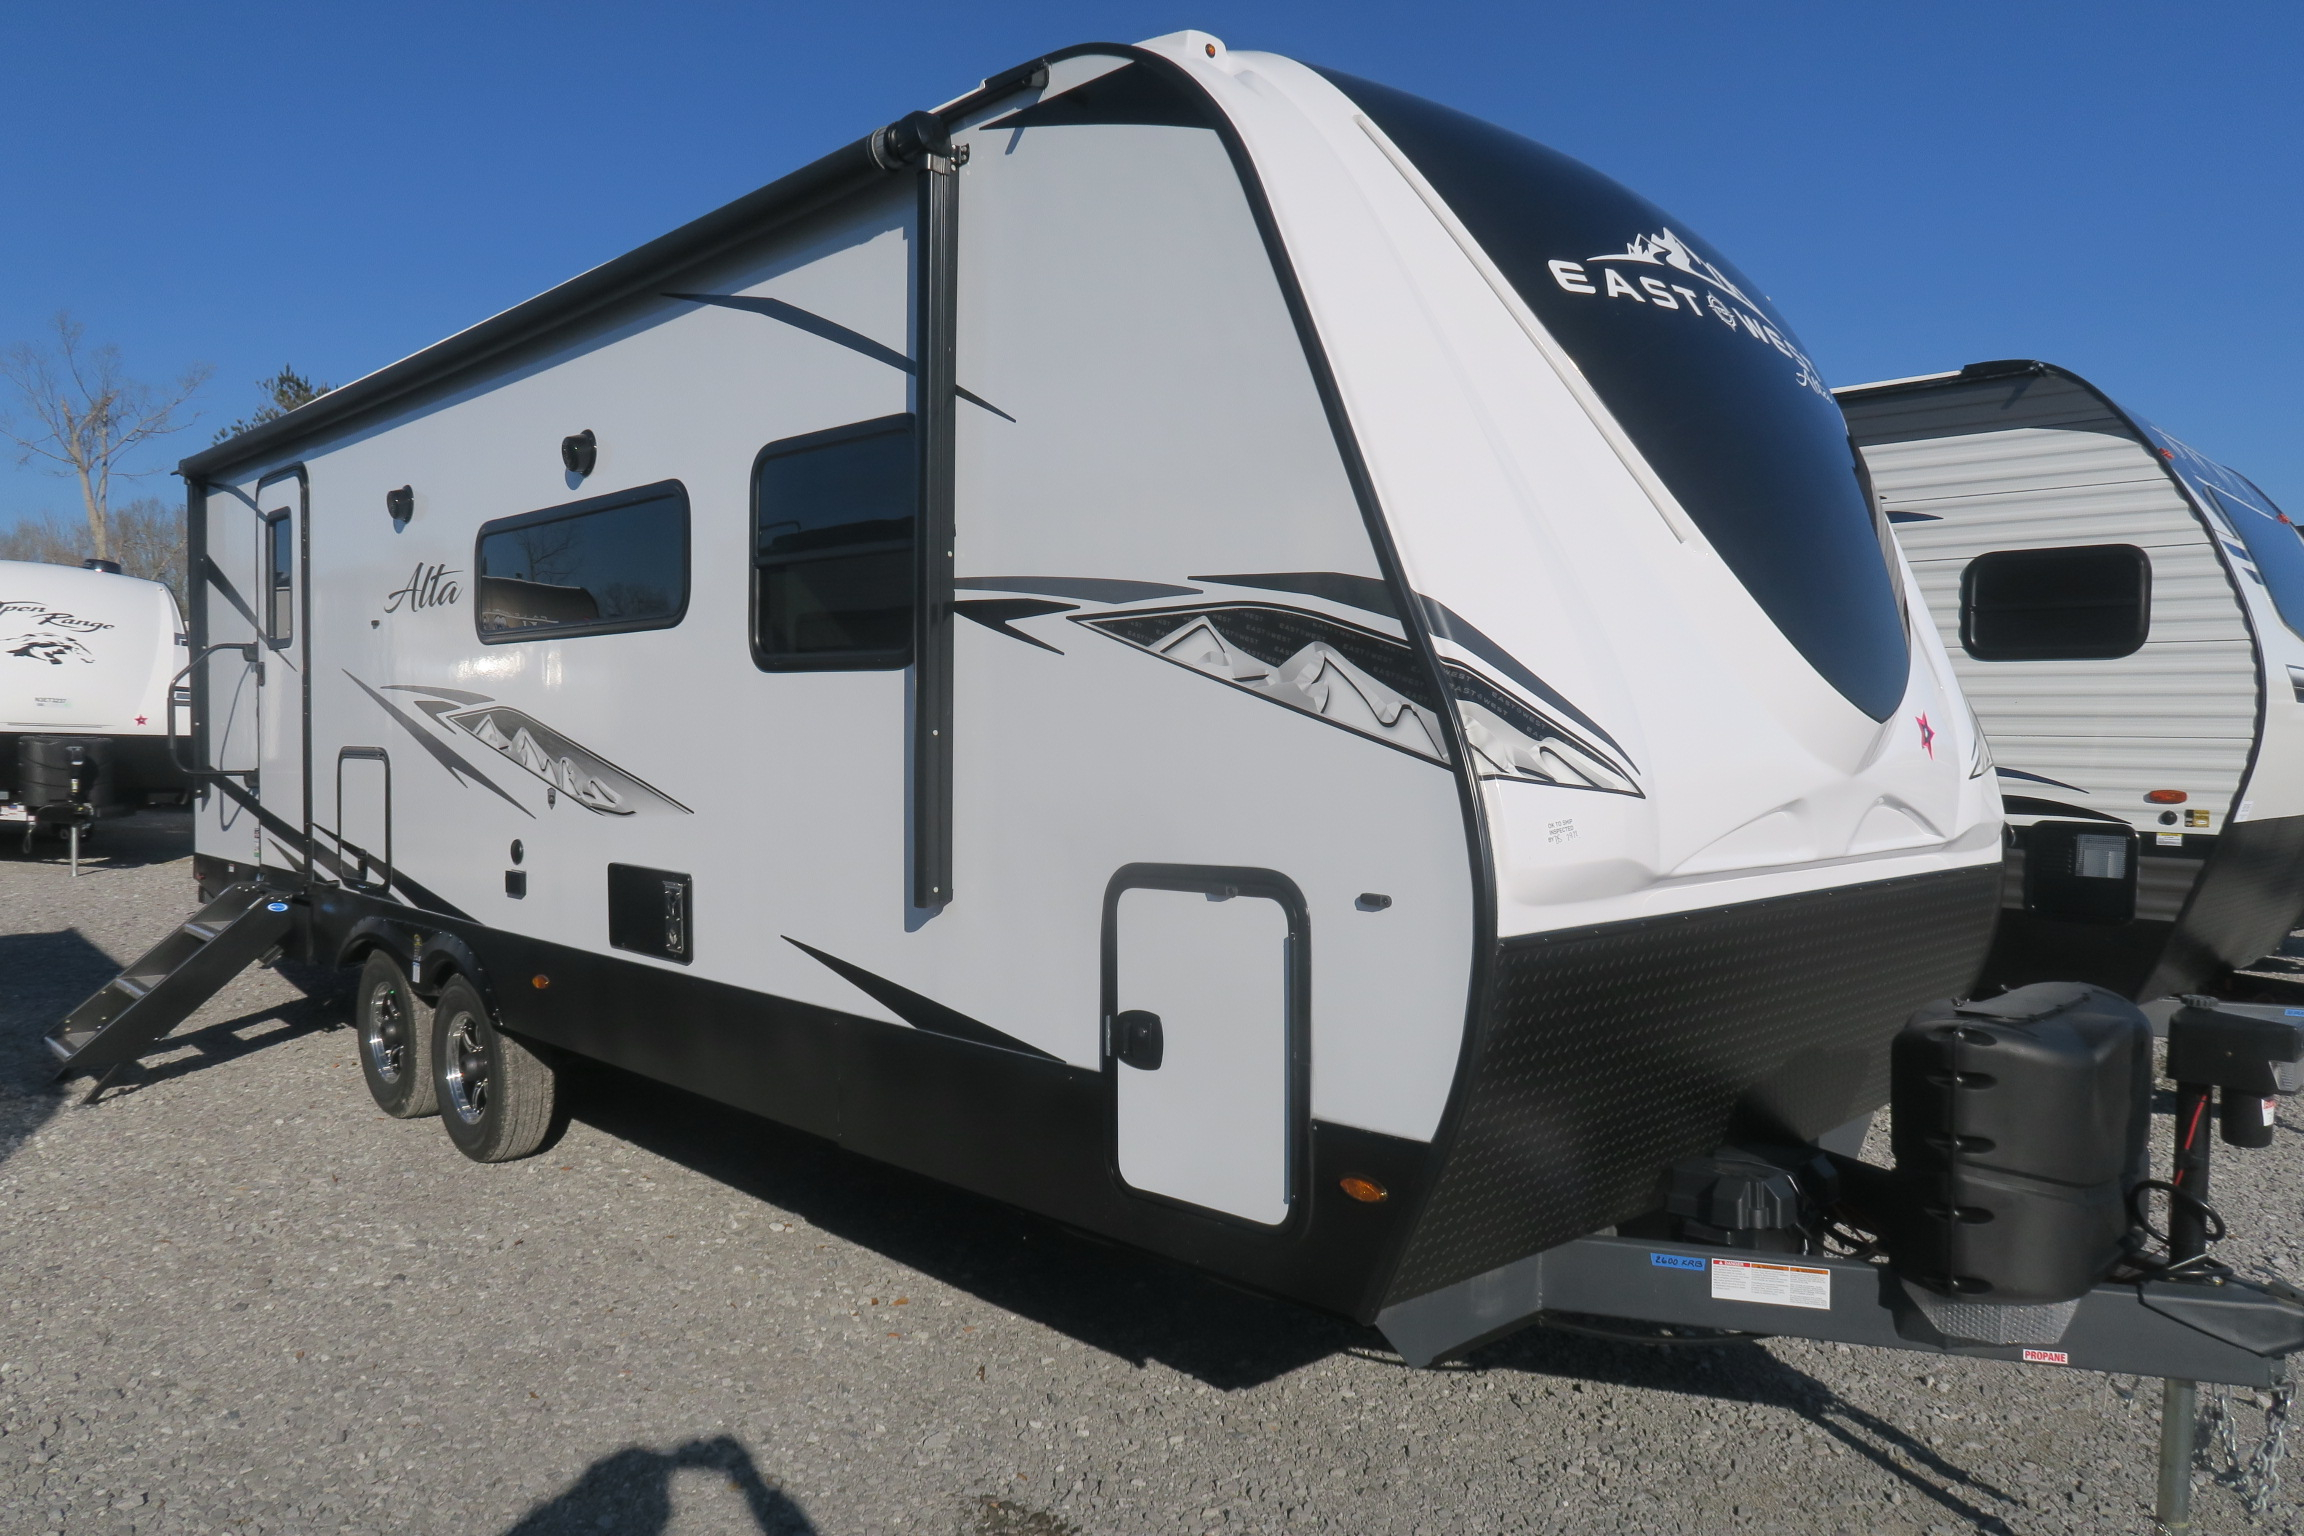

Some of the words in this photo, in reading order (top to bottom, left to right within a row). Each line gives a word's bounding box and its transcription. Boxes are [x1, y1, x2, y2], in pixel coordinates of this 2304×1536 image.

[1547, 259, 1703, 317] EAST
[383, 562, 464, 614] Alta
[30, 612, 115, 632] Range
[1655, 1255, 1679, 1265] 2600
[2024, 1350, 2067, 1363] PROPANE
